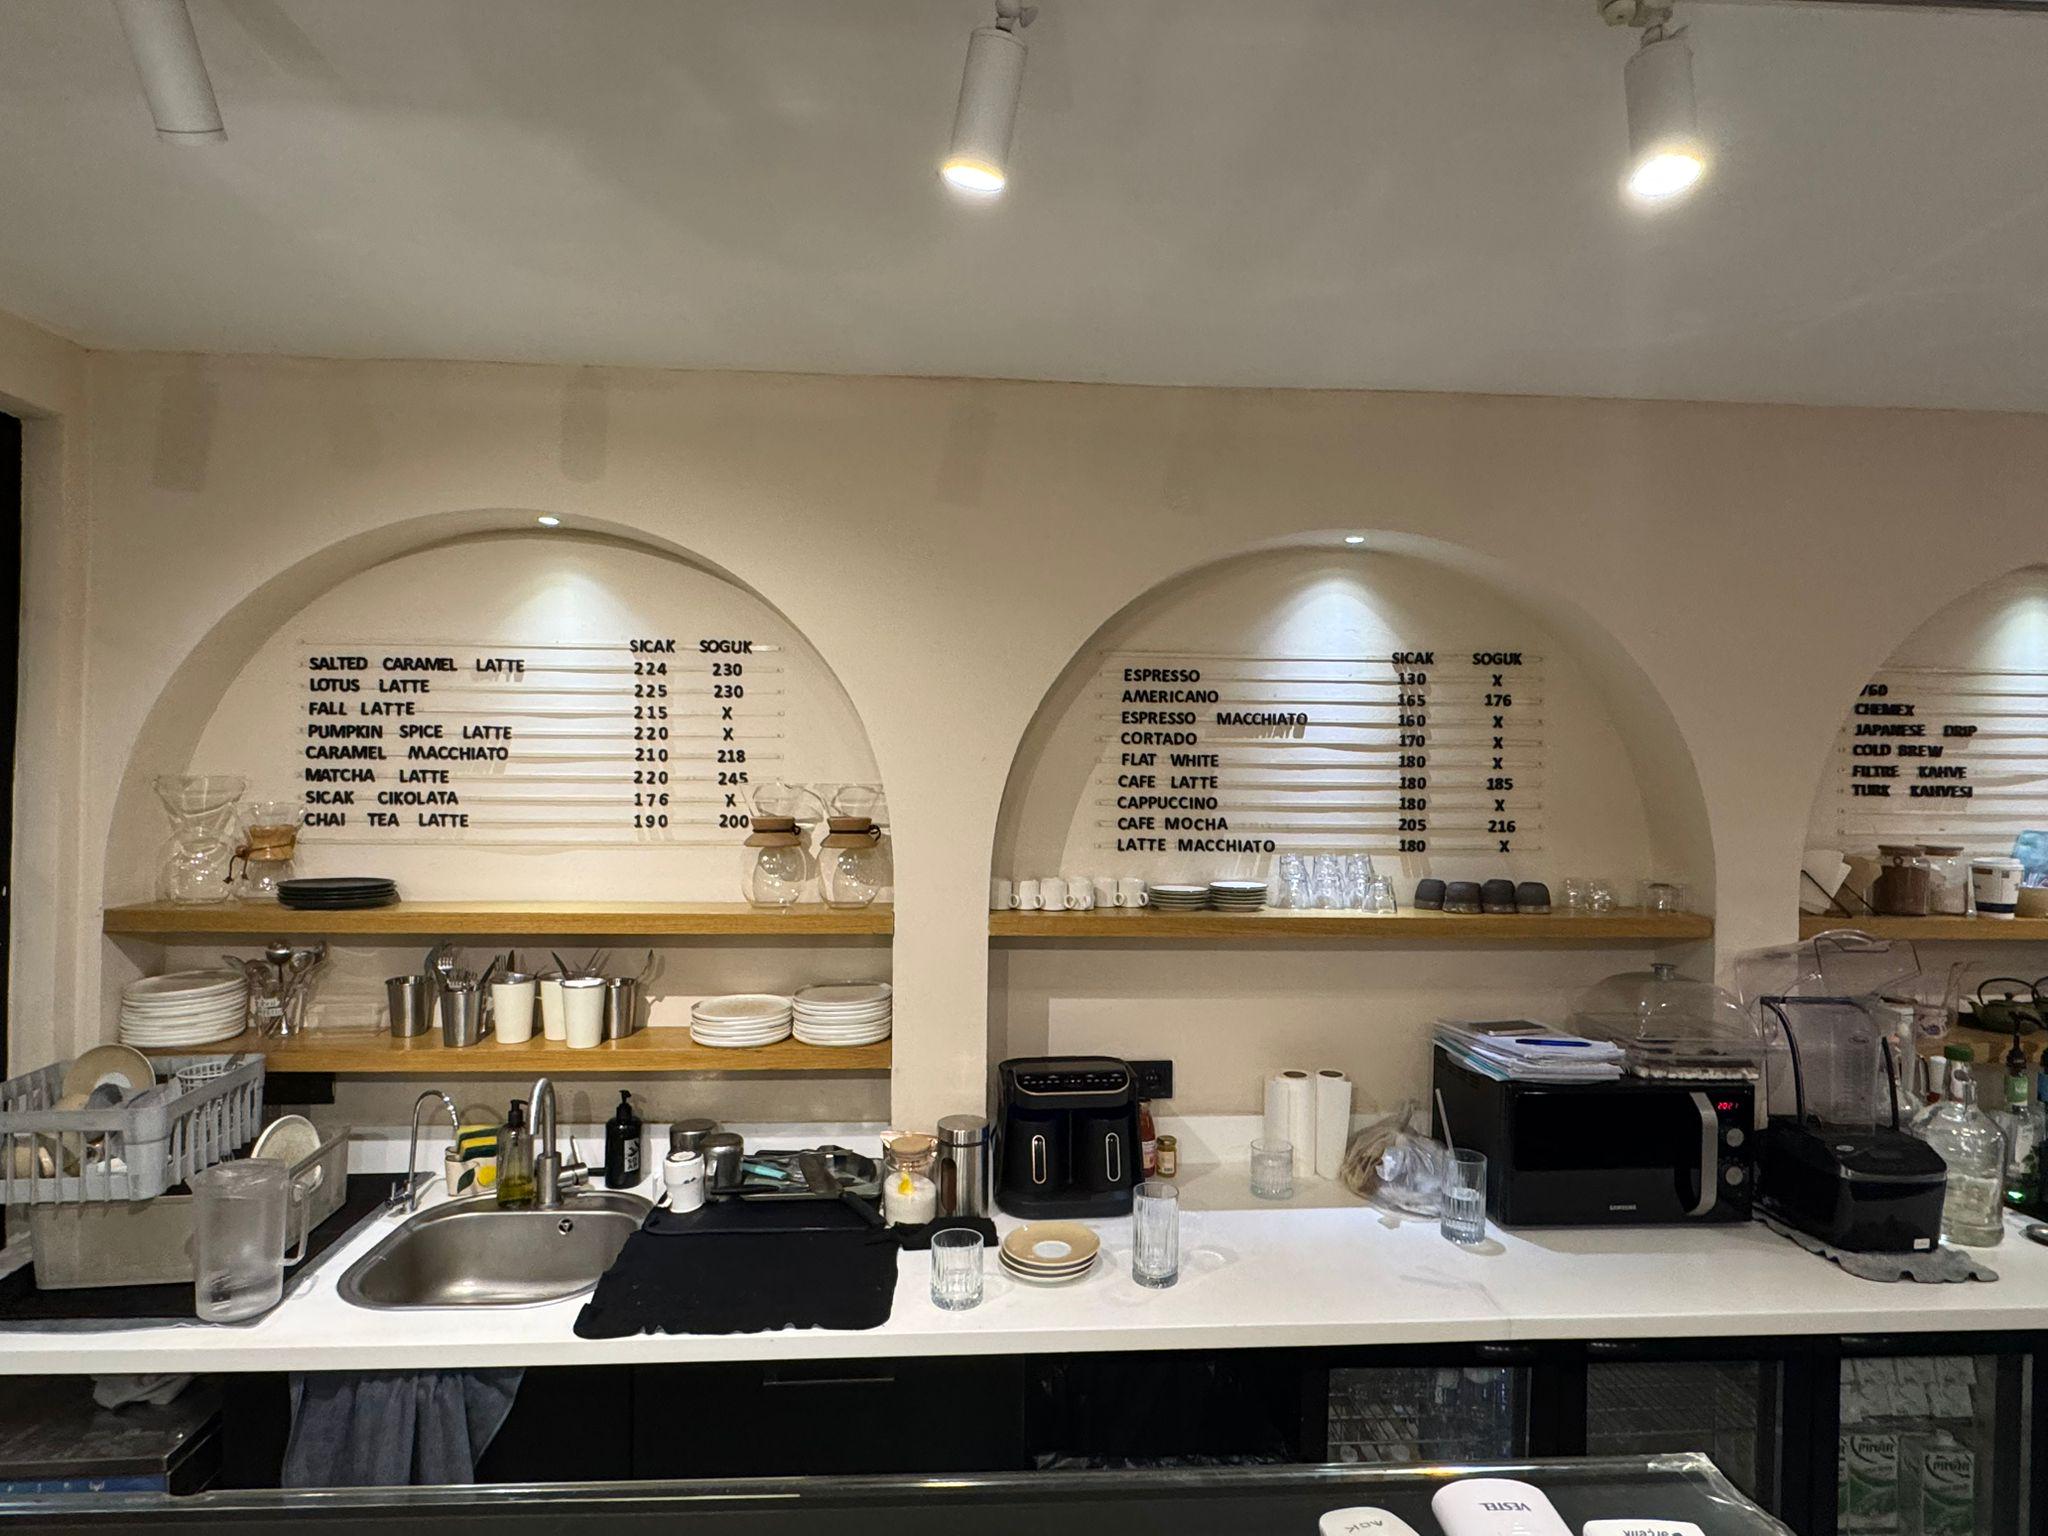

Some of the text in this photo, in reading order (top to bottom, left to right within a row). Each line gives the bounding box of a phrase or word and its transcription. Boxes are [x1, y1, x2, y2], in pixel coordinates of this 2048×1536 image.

[629, 639, 753, 654] SICAK SOGUK
[309, 656, 743, 677] SALTED CARAMEL LATTE 224 230
[1391, 651, 1522, 666] SICAK SOGUK
[1124, 668, 1503, 687] ESPRESSO 130 X
[310, 677, 744, 699] LOTUS LATTE 225 230
[1121, 689, 1512, 708] AMERICANO 165 176
[308, 701, 733, 720] FALL LATTE 215 X
[1854, 703, 1915, 717] CHEMEX
[1121, 711, 1503, 729] ESPRESSO MACCHIATO 160 X
[308, 724, 734, 741] PUMPKIN SPICE LATTE 220 X
[1854, 723, 1978, 738] JAPANESE DRIP
[1120, 731, 1503, 750] CORTADO 170 X
[305, 745, 746, 763] CARAMEL MACCHIATO 210 218
[1852, 743, 1944, 758] COLD BREW
[1121, 752, 1503, 770] FLAT WHITE 180 X
[305, 767, 749, 786] MATCHA LATTE 220 245
[1852, 765, 1966, 779] FILTRE KAHVE
[1117, 774, 1514, 791] CAFE LATTE 180 185
[1851, 783, 1973, 798] TURK KAHVESI
[305, 790, 736, 808] SICAK CIKOLATA 176 X
[1117, 796, 1505, 812] CAPPUCCINO 180 X
[303, 812, 750, 829] CHAI TEA LATTE 190 200
[1117, 816, 1516, 833] CAFE MOCHA 205 216
[1117, 837, 1510, 853] LATTE MACCHIATO 180 X
[1479, 1502, 1531, 1512] VESTEL
